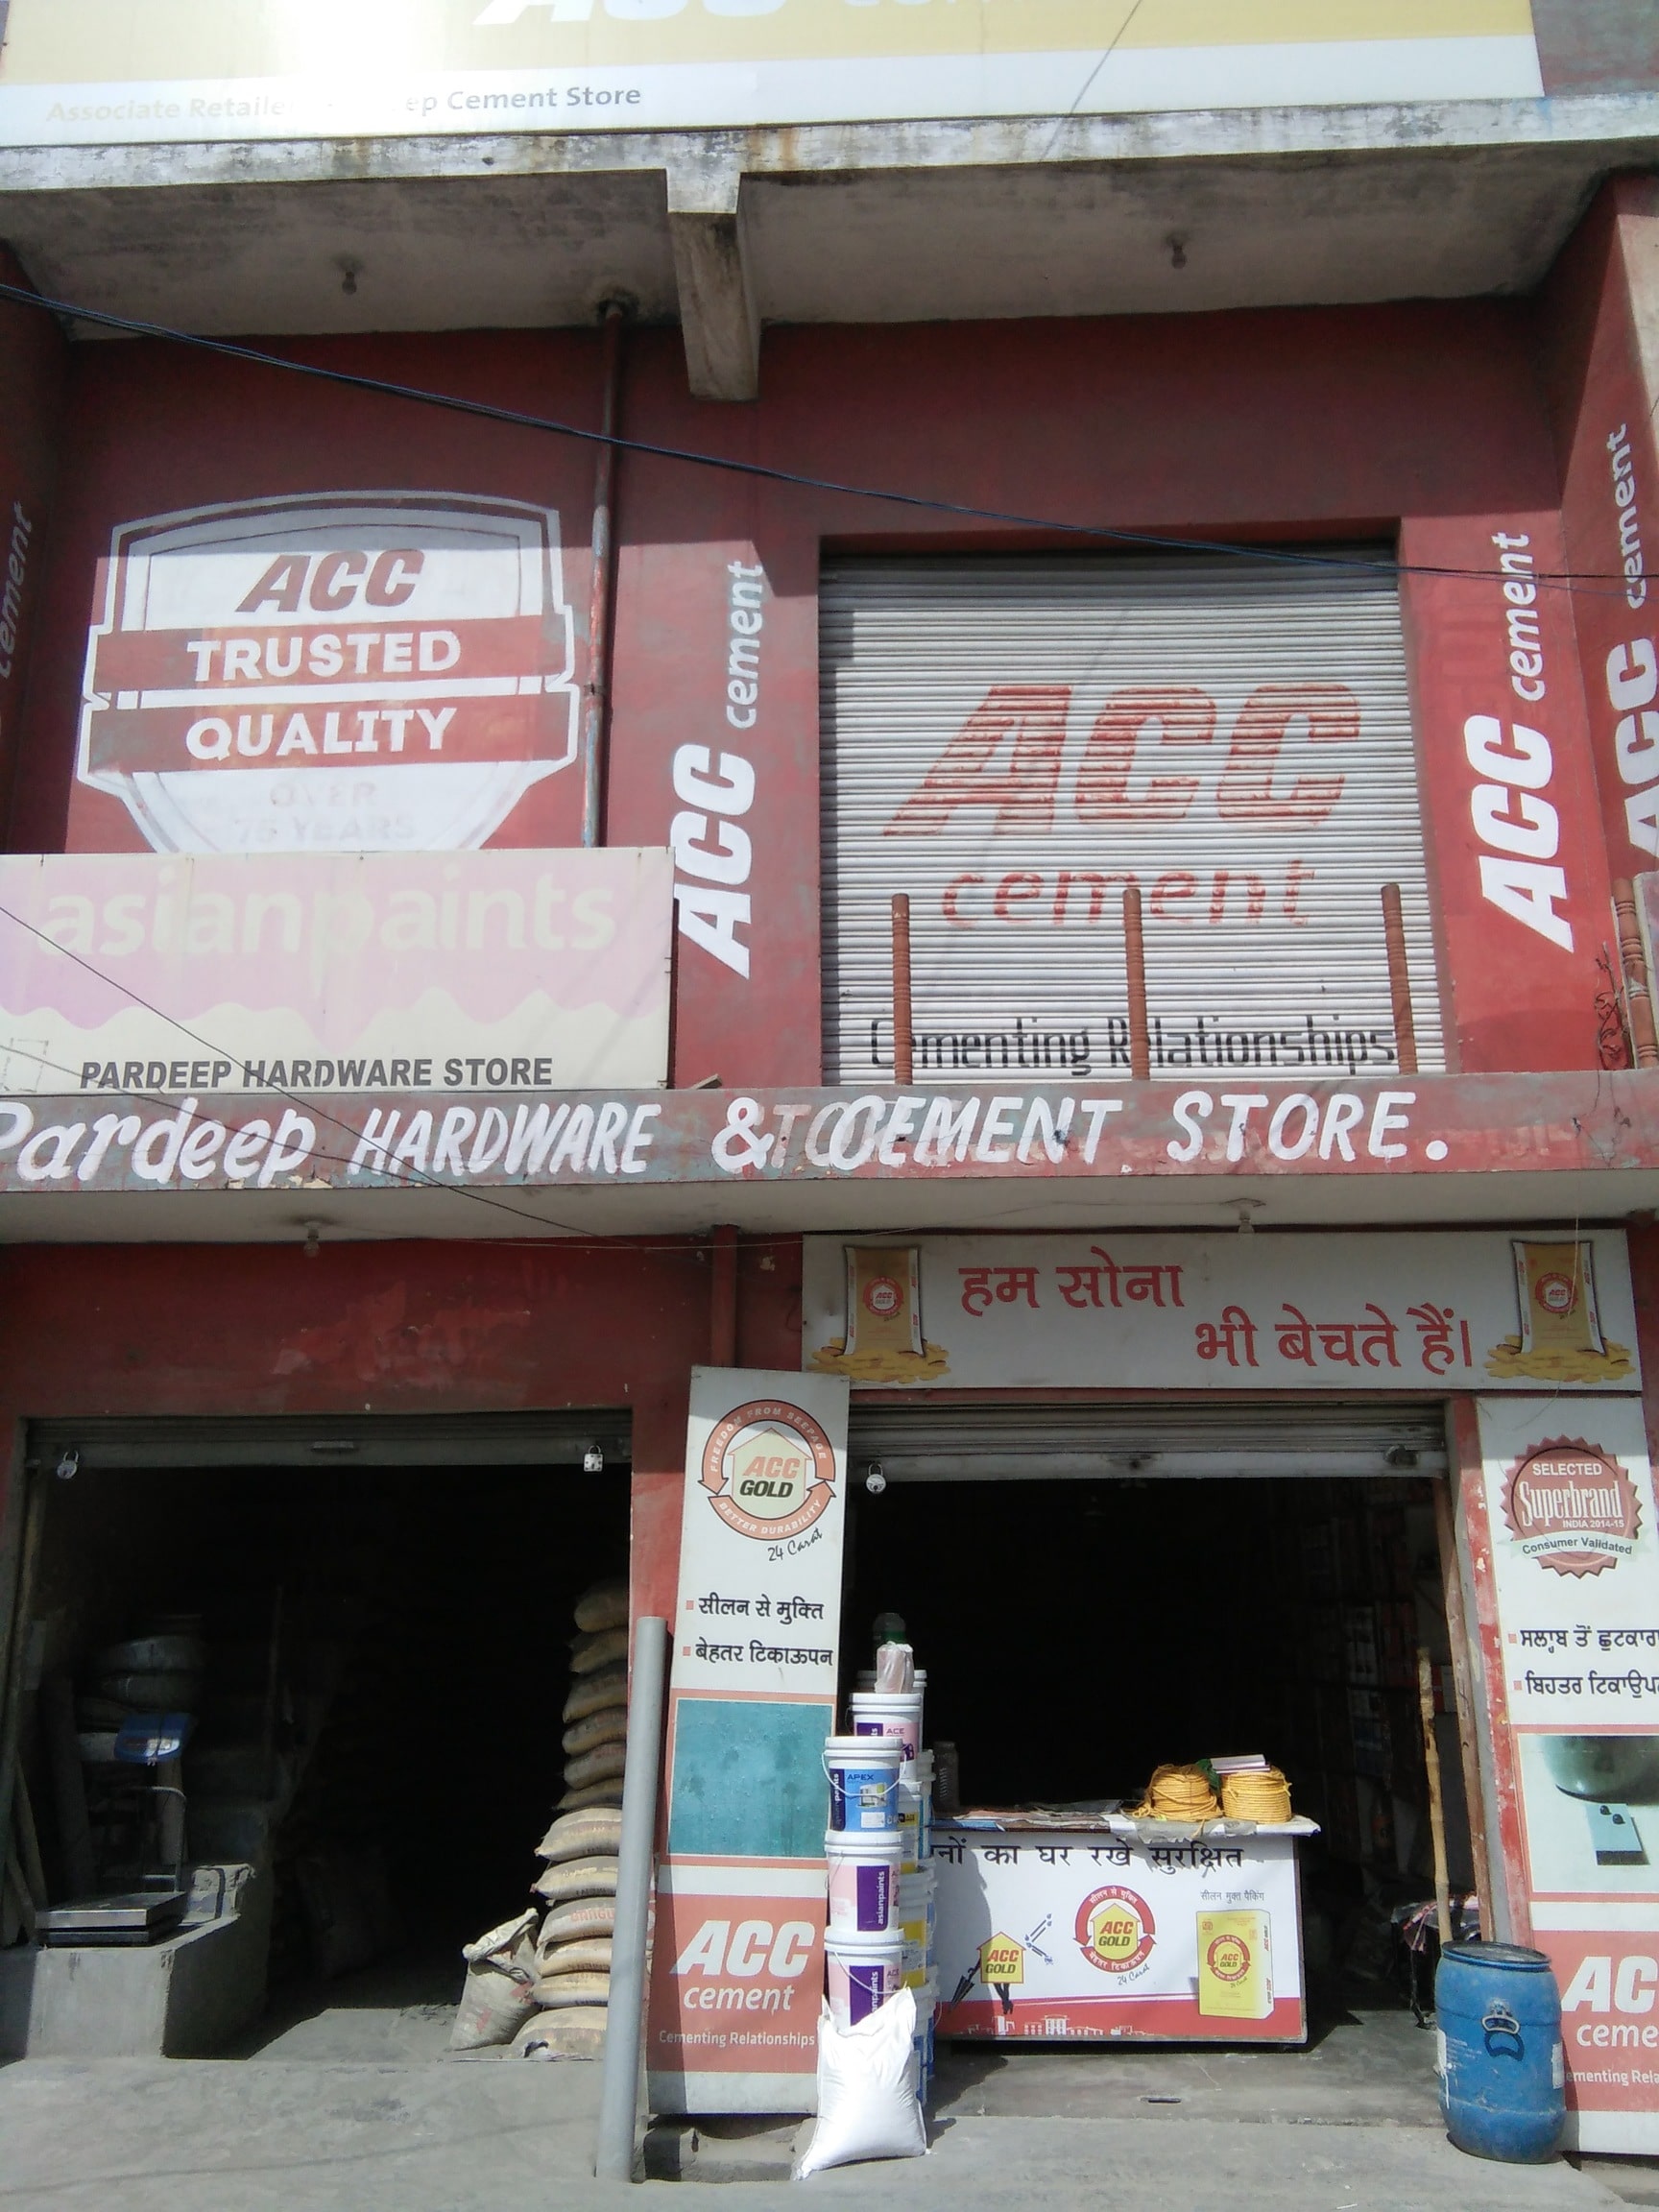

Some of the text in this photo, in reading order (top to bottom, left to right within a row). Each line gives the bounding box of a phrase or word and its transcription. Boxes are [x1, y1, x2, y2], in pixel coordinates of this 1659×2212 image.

[46, 99, 180, 122] Associate
[189, 96, 293, 117] Retaile
[447, 87, 558, 110] Cement
[566, 84, 642, 108] Store
[1606, 422, 1647, 609] cement
[236, 548, 424, 613] ACC
[1491, 531, 1545, 701] cement
[187, 630, 461, 683] TRUSTED
[726, 561, 764, 729] cement
[186, 708, 456, 762] QUALITY
[883, 684, 1361, 836] ACC
[270, 781, 377, 808] OVER
[291, 816, 417, 842] YEARS
[1463, 714, 1574, 953] ACC
[670, 744, 756, 980] ACC
[942, 858, 1315, 927] cement
[39, 864, 615, 999] asianpaints
[871, 1015, 1396, 1076] Cmenting Rlationships
[80, 1056, 553, 1090] PARDEEP HARDWARE STORE
[0, 1096, 316, 1187] Pardeep
[348, 1101, 662, 1179] HARDWARE
[711, 1096, 774, 1173] &
[830, 1094, 1123, 1170] CEMENT
[1166, 1090, 1449, 1164] STORE.
[959, 1246, 1186, 1318] हम सोना
[1194, 1306, 1259, 1369] भी
[1278, 1303, 1403, 1370] बेचते
[709, 1407, 827, 1473] FREEDOM FROM SEEPAGE
[742, 1455, 801, 1479] ACC
[1532, 1462, 1602, 1478] SELECTED
[739, 1479, 794, 1499] GOLD
[1519, 1479, 1623, 1528] Superbrand
[719, 1499, 822, 1535] BETTER DURABILITY
[1562, 1519, 1588, 1529] INDIA
[767, 1527, 823, 1562] 24 Carat
[1522, 1537, 1633, 1556] Consumer Validated
[699, 1592, 824, 1625] सीलन से मुक्ति
[695, 1636, 833, 1667] बेहतर टिकाऊपन
[1525, 1670, 1584, 1695] ਬਿਹਤਰ
[980, 1844, 1022, 1865] का
[1035, 1844, 1073, 1866] घर
[1087, 1838, 1134, 1866] रखे
[1147, 1840, 1245, 1875] सुरक्षित
[876, 1870, 885, 1925] asianpaints
[1200, 1888, 1222, 1902] सीलन
[1225, 1890, 1241, 1904] मुक्त
[1098, 1936, 1130, 1947] GOLD
[1100, 1920, 1134, 1935] ACC
[671, 1919, 815, 1978] ACC
[986, 1949, 1019, 1963] ACC
[1220, 1953, 1239, 1961] ACC
[985, 1962, 1017, 1975] GOLD
[1117, 1974, 1128, 1986] 24
[683, 1984, 795, 2012] cement
[659, 2029, 815, 2048] Cementing Relationships
[1566, 2070, 1629, 2087] ementing
